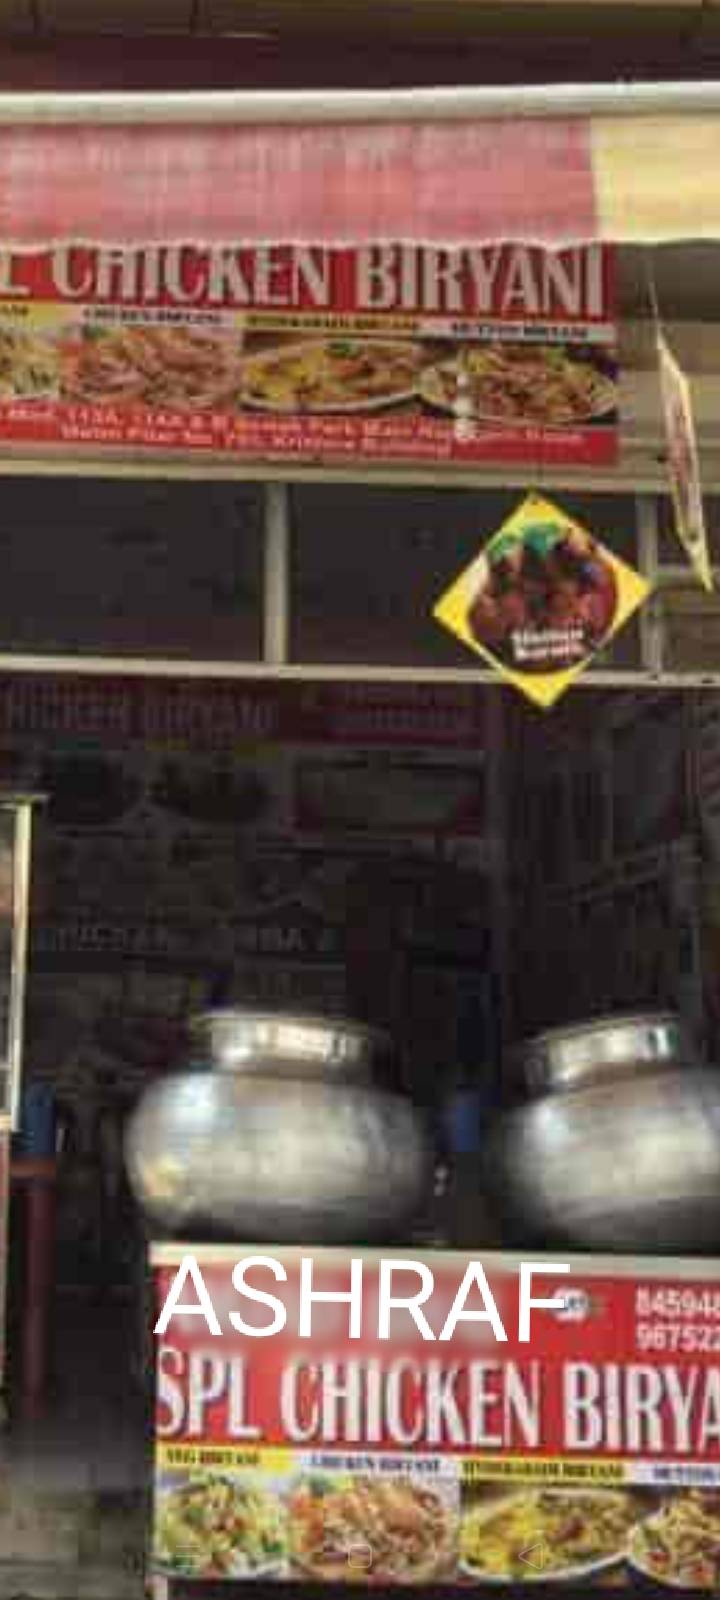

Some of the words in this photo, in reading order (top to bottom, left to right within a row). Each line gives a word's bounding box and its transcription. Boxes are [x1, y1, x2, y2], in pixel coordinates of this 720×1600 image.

[53, 243, 329, 306] CHICKEN
[357, 246, 603, 316] BIRYANI
[156, 1345, 260, 1440] SPL
[280, 1352, 541, 1450] CHICKEN
